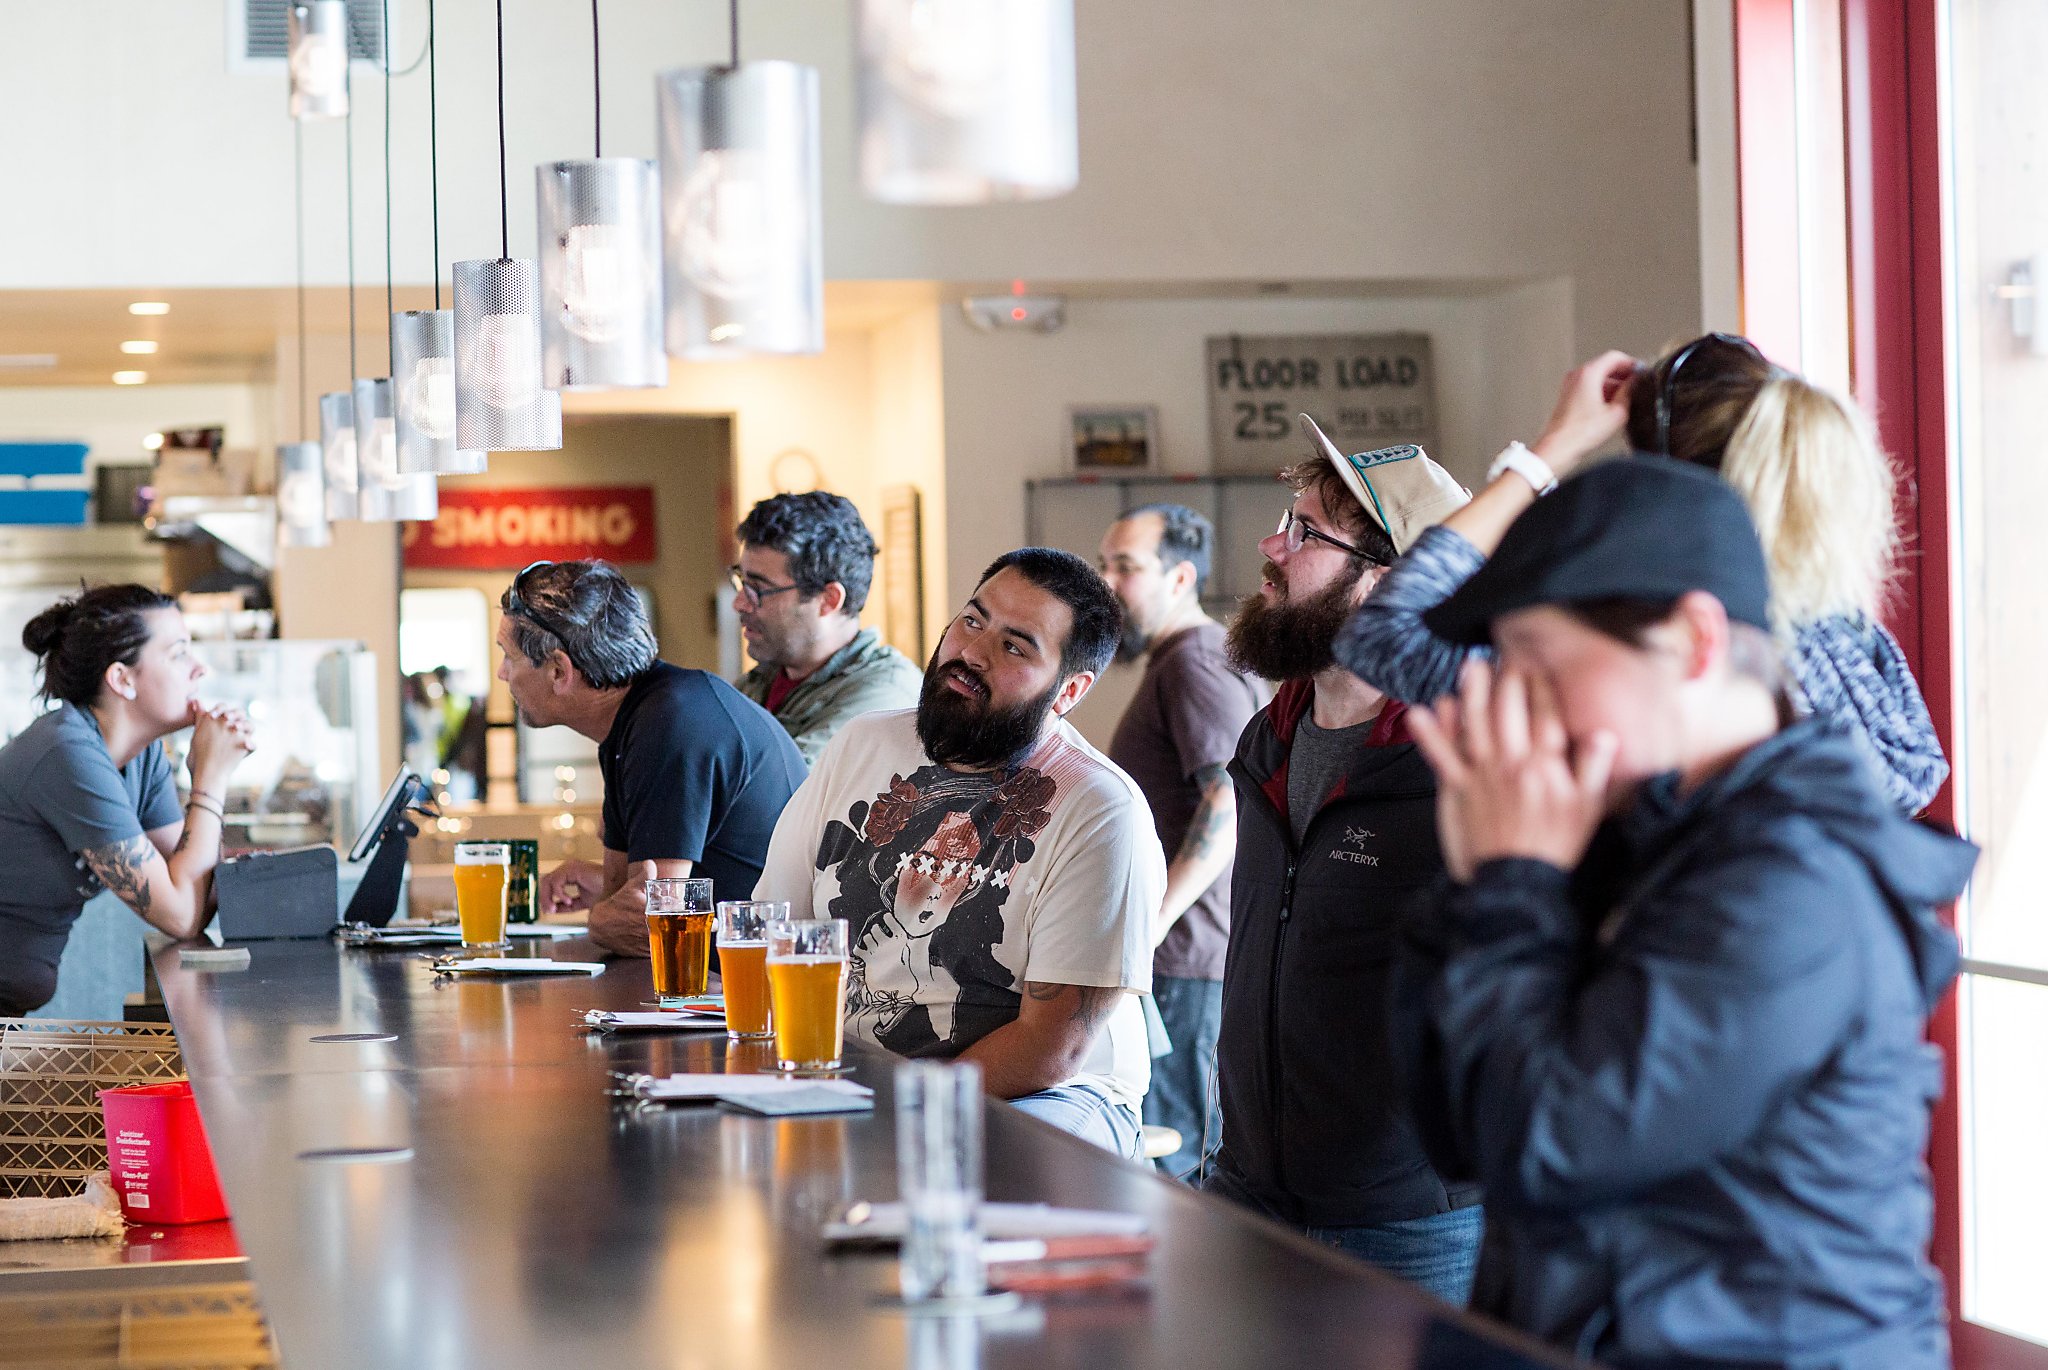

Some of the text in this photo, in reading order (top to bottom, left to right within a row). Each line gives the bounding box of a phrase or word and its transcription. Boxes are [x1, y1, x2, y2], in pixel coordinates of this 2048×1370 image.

[1217, 356, 1418, 390] FLOOR LOAD
[1233, 400, 1292, 440] 25
[431, 504, 635, 548] SMOKING
